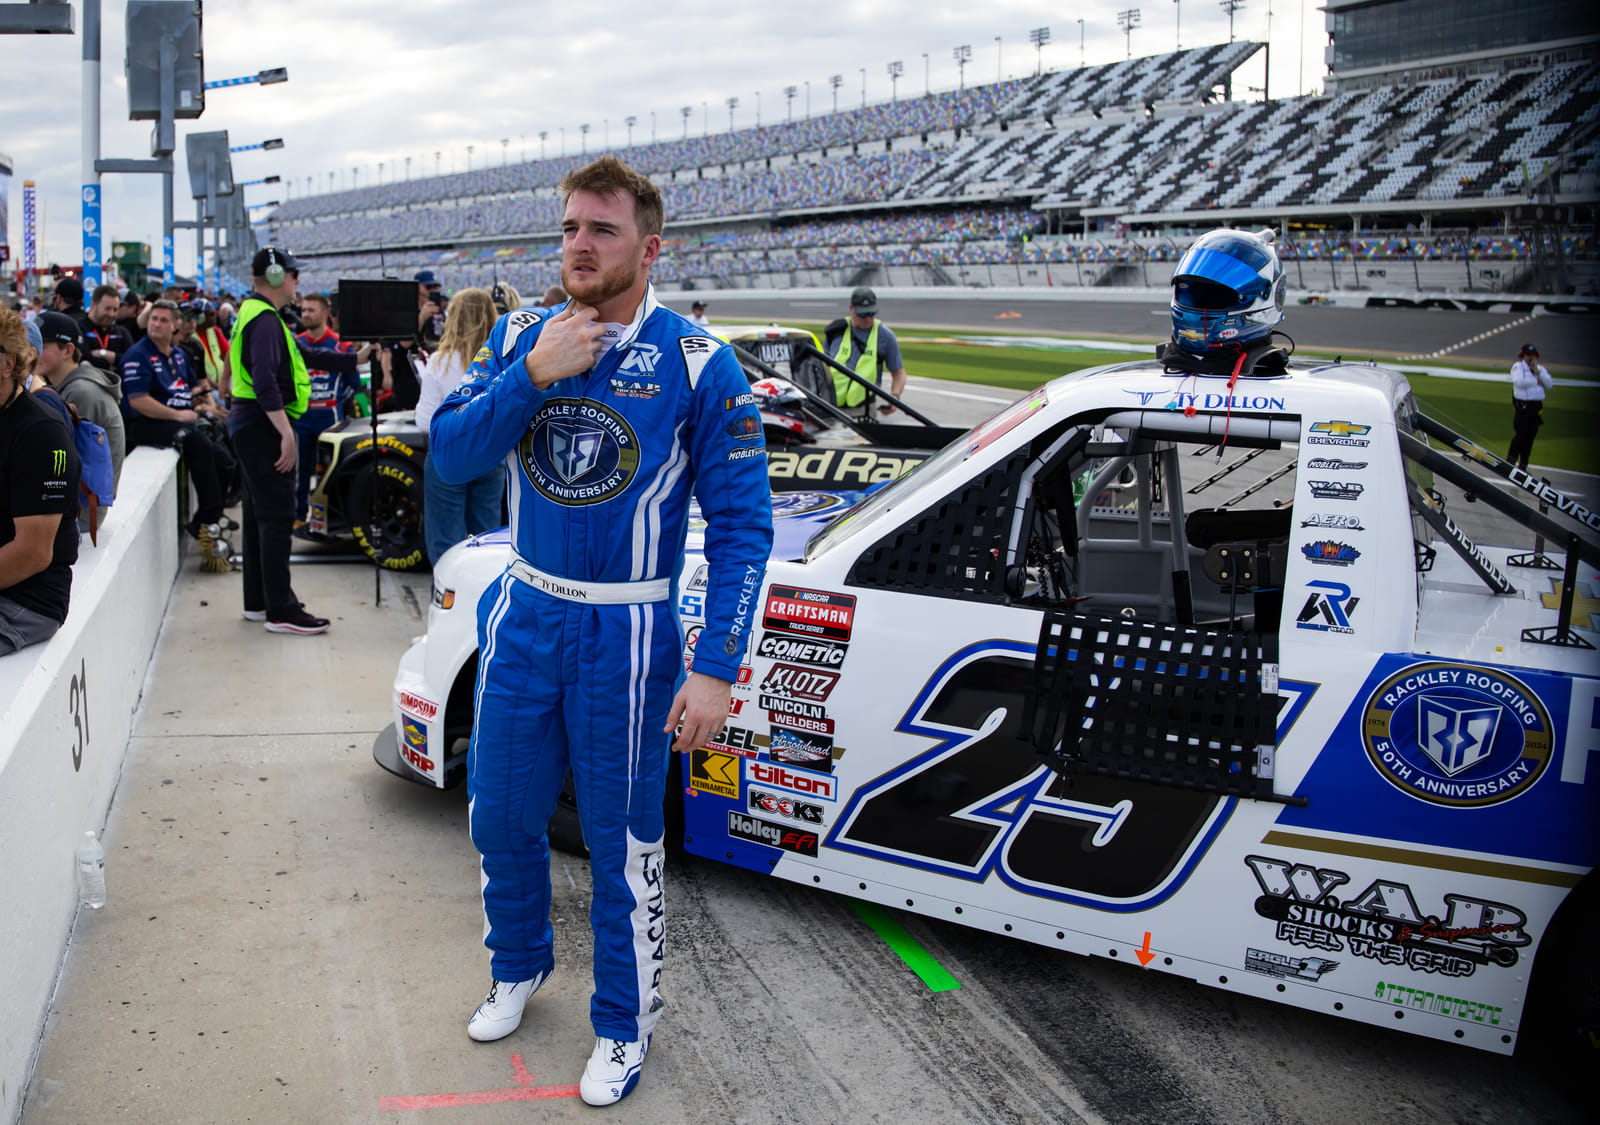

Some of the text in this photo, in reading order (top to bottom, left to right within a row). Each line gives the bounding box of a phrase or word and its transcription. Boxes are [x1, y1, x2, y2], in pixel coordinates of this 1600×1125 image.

[1204, 393, 1284, 411] DILLON
[529, 405, 629, 445] RACKLEY ROOFING
[1307, 436, 1370, 448] CHEVROLET
[527, 456, 547, 491] 50TH
[1304, 513, 1361, 528] AERO
[551, 583, 587, 599] DILLON
[730, 564, 758, 637] RACKLEY
[802, 592, 830, 604] NASCAR
[770, 600, 849, 625] CRAFTSMAN
[788, 621, 825, 634] TRUCK SERIES
[760, 637, 845, 665] COMETIC
[769, 667, 835, 696] KLOTZ
[400, 691, 438, 719] SIMPSON
[761, 698, 823, 719] LINCOLN
[1384, 671, 1537, 726] RACKLEY ROOFING
[69, 656, 90, 773] 31
[774, 712, 828, 733] WELDERS
[1366, 718, 1386, 728] 1974
[402, 743, 436, 773] ARP
[770, 734, 832, 756] Arrowhead
[1525, 740, 1548, 751] 2024
[750, 763, 831, 797] tilton
[1376, 741, 1530, 798] 50TH ANNIVERSARY
[691, 779, 737, 798] KENNAMETAL
[749, 790, 825, 825] KOOKS
[729, 812, 782, 846] Holley
[1287, 903, 1396, 941] SHOCKS
[1414, 921, 1517, 944] Suspension
[1246, 948, 1301, 969] EAGLE
[1275, 920, 1477, 978] FEEL THE GRIP
